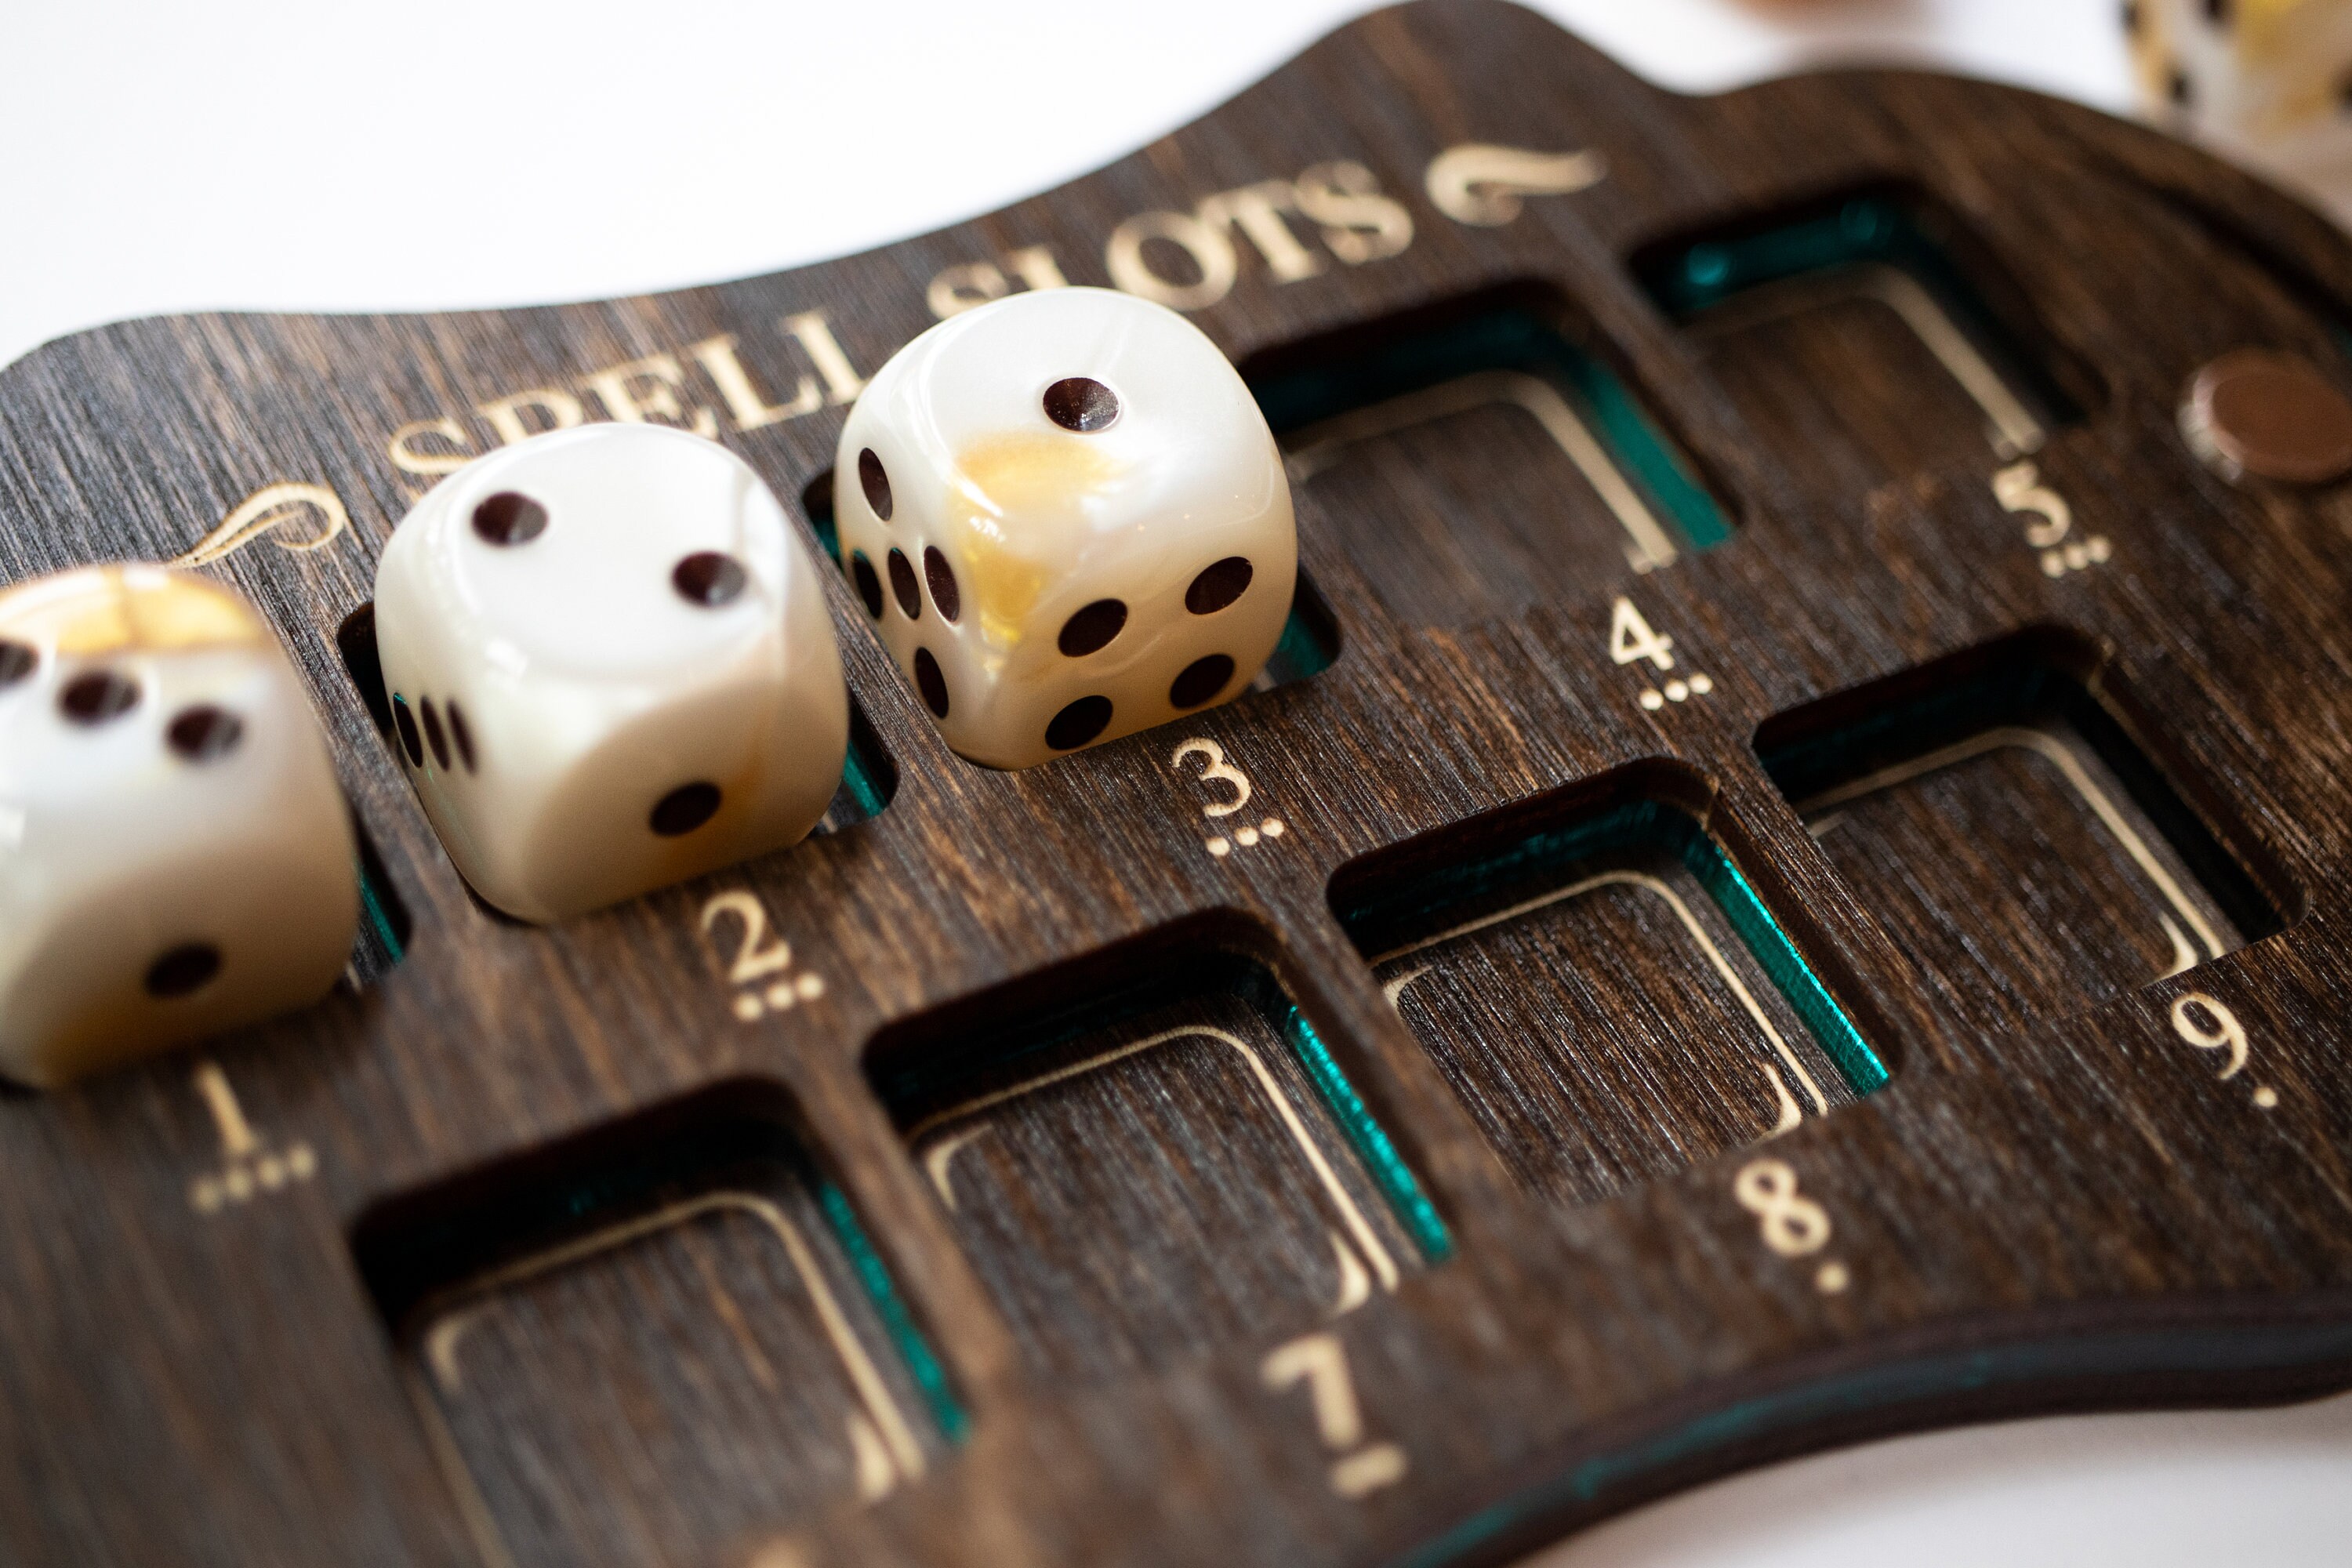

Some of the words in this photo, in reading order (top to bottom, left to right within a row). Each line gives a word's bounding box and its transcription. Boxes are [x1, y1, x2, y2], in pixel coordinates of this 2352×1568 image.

[1991, 459, 2071, 547] 5
[1610, 595, 1675, 671] 4
[1173, 737, 1251, 817] 3
[701, 889, 792, 985] 2
[2170, 991, 2249, 1081] 9
[195, 1057, 263, 1156] 1
[1735, 1157, 1831, 1258] 8
[1259, 1331, 1364, 1450] 7
